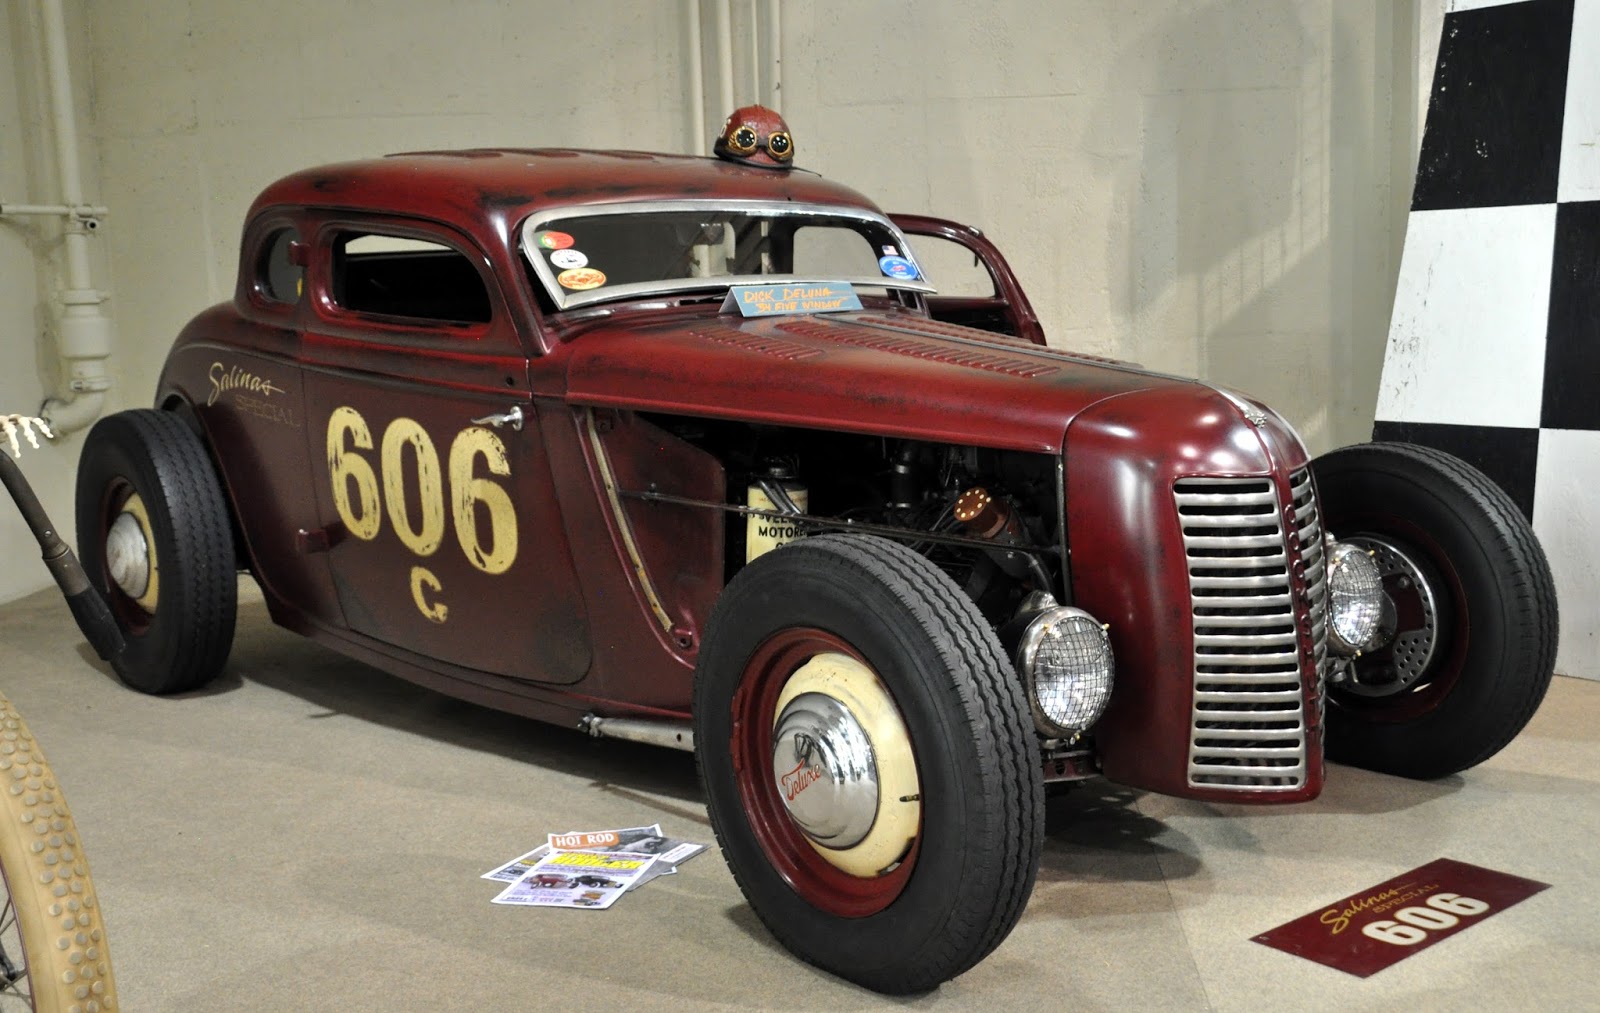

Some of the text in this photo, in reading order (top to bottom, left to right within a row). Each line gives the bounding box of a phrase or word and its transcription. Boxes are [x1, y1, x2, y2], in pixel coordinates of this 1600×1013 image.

[743, 288, 775, 304] DICK
[207, 361, 286, 407] Salinas
[326, 406, 519, 575] 606
[781, 757, 821, 801] Deluxe
[555, 833, 615, 847] HOT ROD
[1320, 882, 1418, 935] Salinas
[1361, 892, 1490, 946] 606
